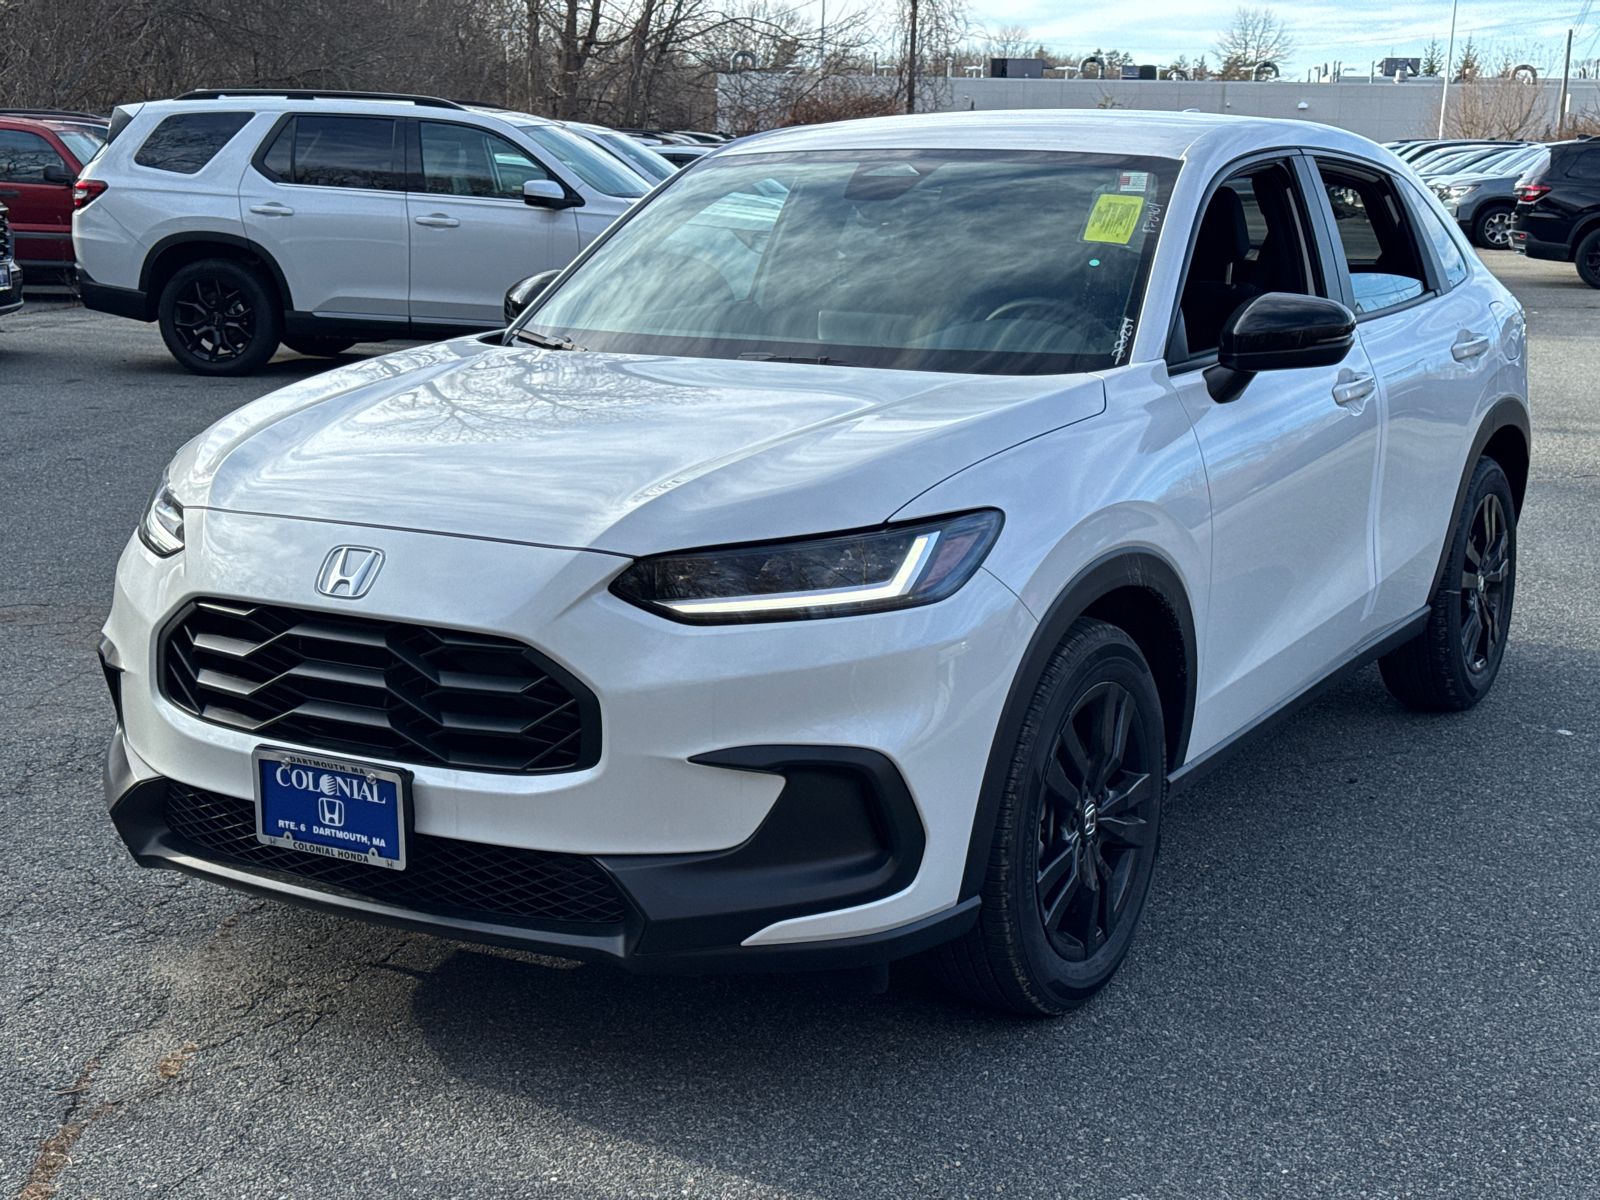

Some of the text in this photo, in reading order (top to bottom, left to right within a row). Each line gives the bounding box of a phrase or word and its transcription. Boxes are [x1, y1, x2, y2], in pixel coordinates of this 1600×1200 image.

[350, 766, 366, 775] MA
[275, 766, 386, 804] COLONIAL
[277, 819, 386, 847] RTE. 6 DARTMOUTH, MA
[292, 841, 370, 863] COLONIAL HONDA
